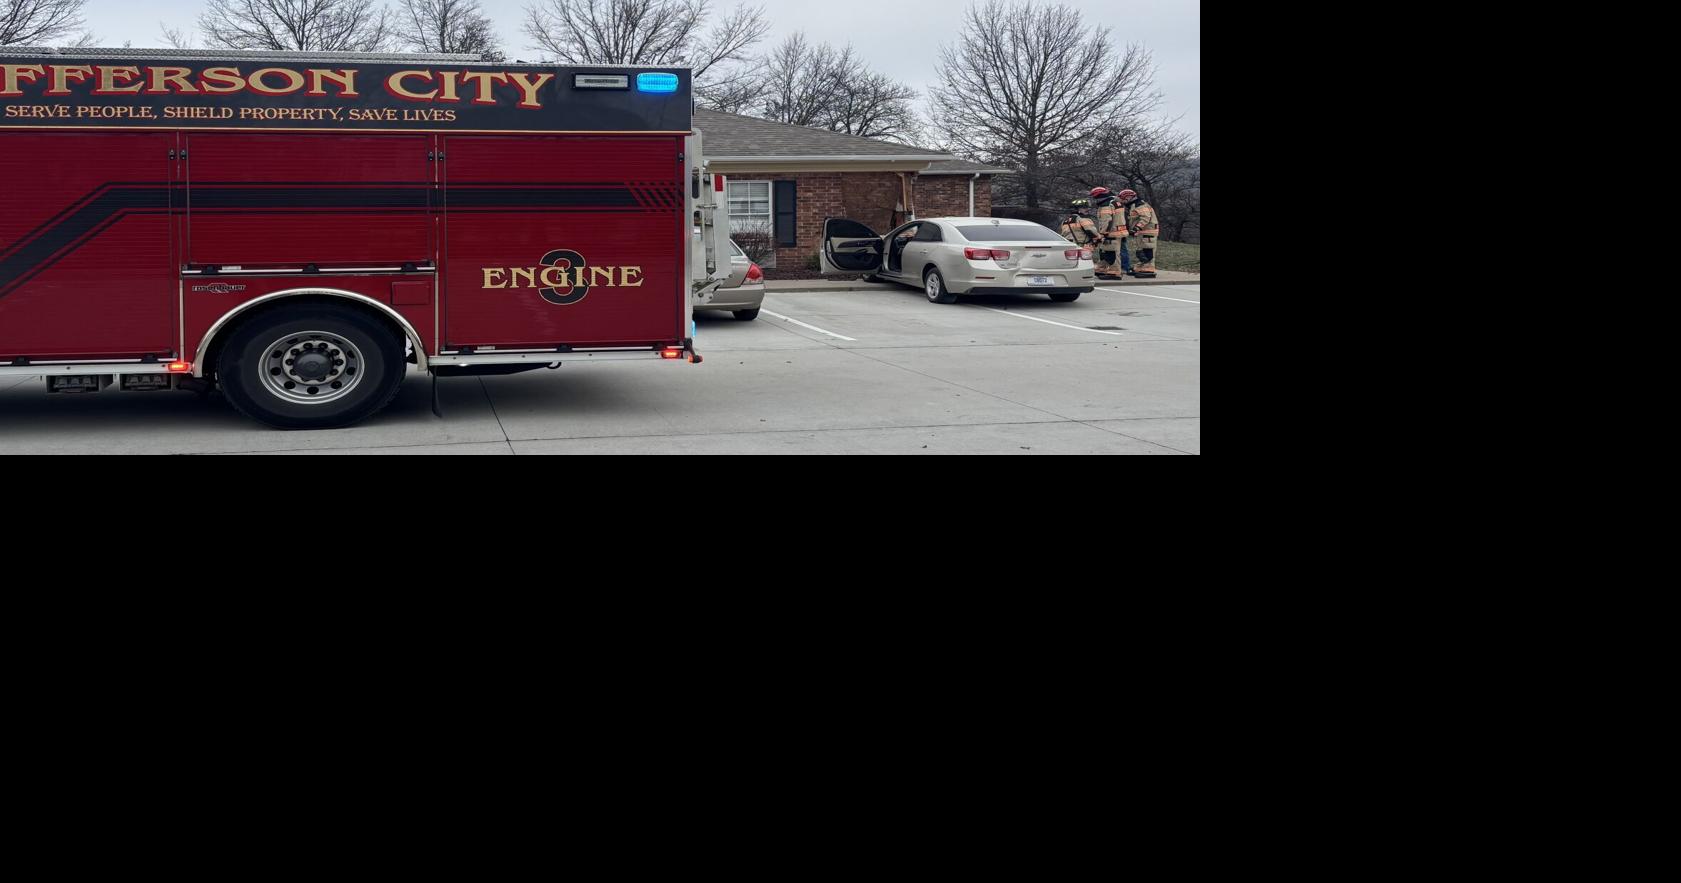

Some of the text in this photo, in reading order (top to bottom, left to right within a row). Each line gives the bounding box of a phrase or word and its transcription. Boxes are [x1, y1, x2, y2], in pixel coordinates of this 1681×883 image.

[384, 69, 555, 110] CITY
[5, 104, 457, 122] SERVE PEOPLE, SHIELD PROPERTY, SAVE LIVES
[481, 265, 644, 289] ENGINE
[538, 248, 590, 305] 3
